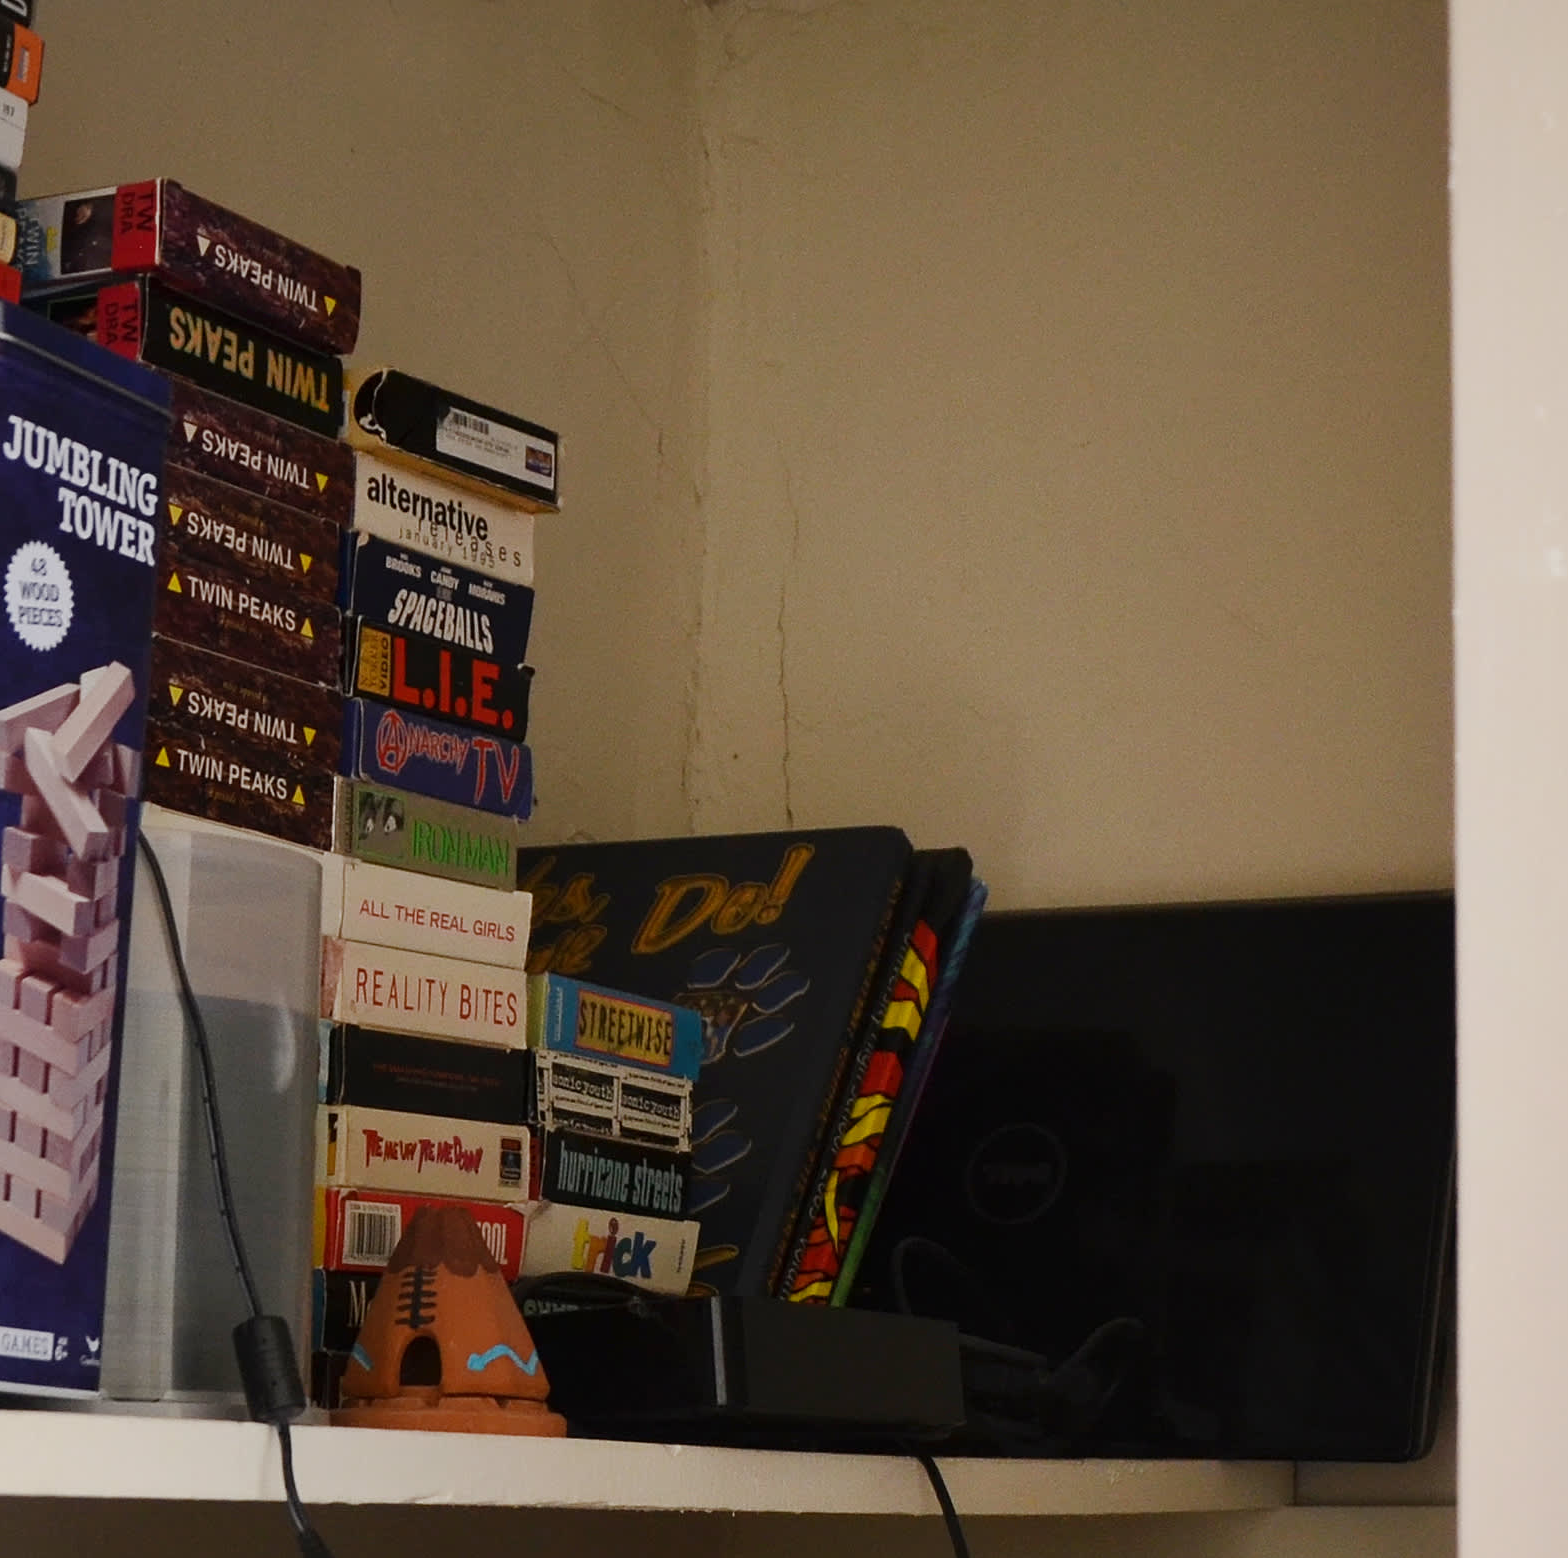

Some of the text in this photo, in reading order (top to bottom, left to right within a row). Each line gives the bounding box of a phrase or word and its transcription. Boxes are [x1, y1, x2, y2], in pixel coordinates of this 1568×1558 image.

[214, 244, 318, 312] TWIN PEAKS
[169, 306, 330, 414] TWIN PEAKS
[3, 414, 159, 517] JUMBLING
[201, 430, 310, 489] TWIN PEAKS
[57, 487, 156, 567] TOWER
[367, 473, 488, 541] alternative
[187, 512, 295, 571] TWIN PEAKS
[417, 519, 522, 568] releases
[17, 580, 61, 602] WOOD
[17, 606, 63, 628] PIECES
[186, 576, 296, 631] TWIN PEAKS
[387, 588, 494, 655] SPACEBALLS
[379, 637, 389, 690] VIDEO
[393, 636, 514, 730] L.I.E.
[187, 691, 298, 744] TWIN PEAKS
[177, 749, 288, 800] TWIN PEAKS
[471, 735, 520, 805] TV
[359, 899, 516, 943] ALL THE REAL GIRLS
[355, 967, 448, 1017] REALITY
[459, 983, 518, 1028] BITES
[578, 1000, 673, 1057] STREETWISE
[557, 1139, 683, 1215] hurricane streets
[570, 1216, 657, 1280] trick
